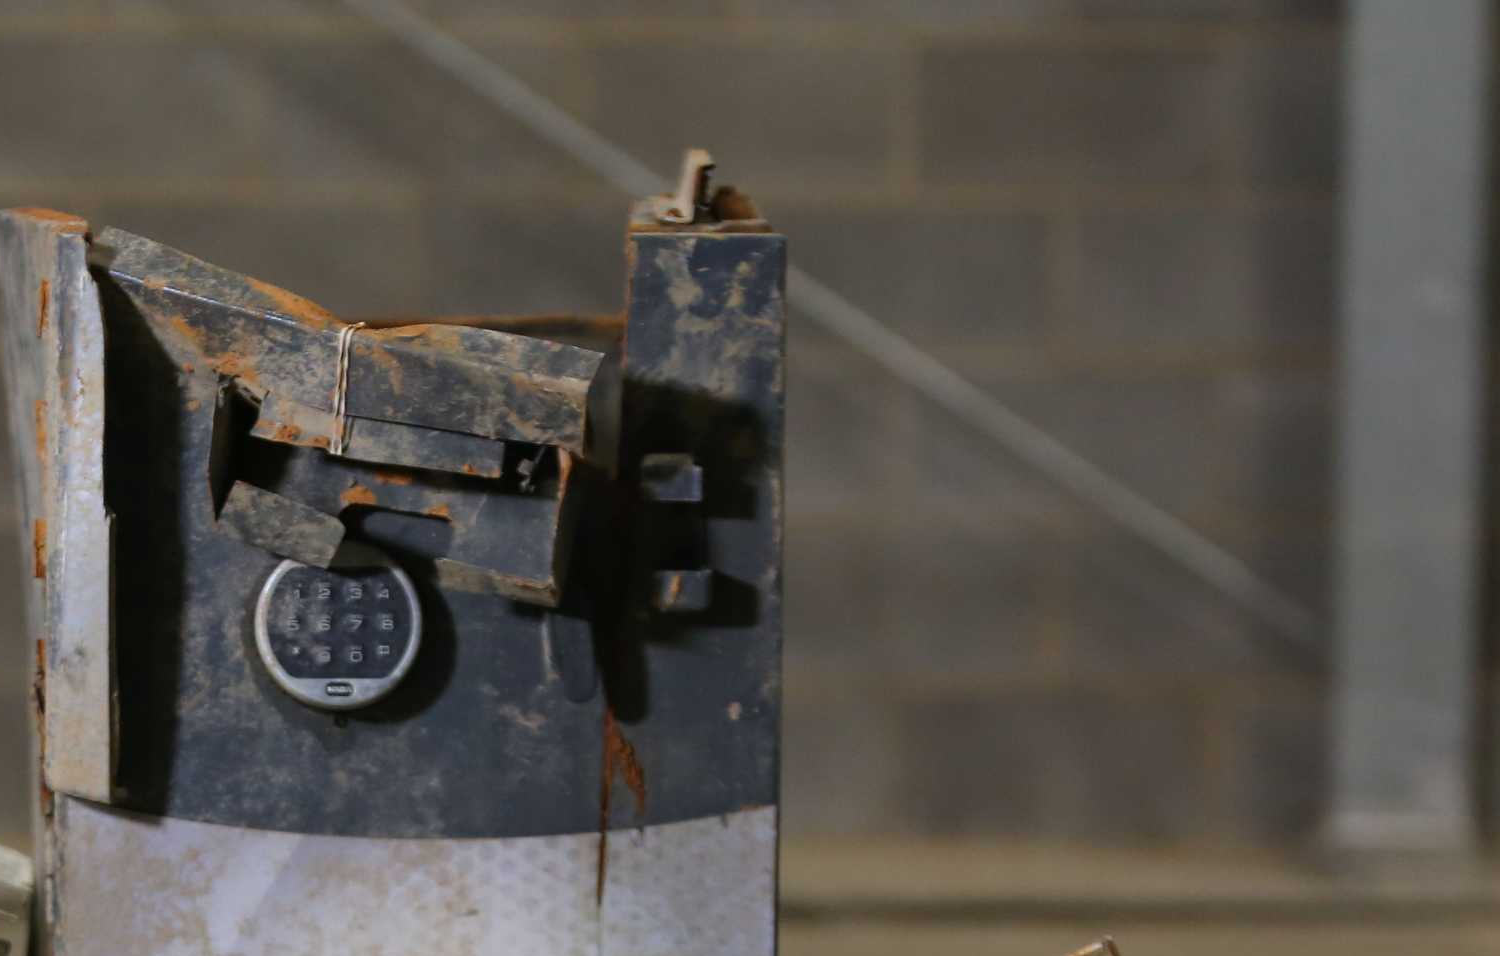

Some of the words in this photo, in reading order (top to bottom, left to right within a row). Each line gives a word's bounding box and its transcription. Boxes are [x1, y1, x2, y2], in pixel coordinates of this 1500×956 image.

[318, 588, 331, 599] 2
[350, 588, 362, 599] 3
[288, 620, 299, 631] 5
[318, 620, 331, 631] 6
[350, 620, 362, 631] 7
[382, 620, 394, 631] 8
[350, 651, 363, 662] 0
